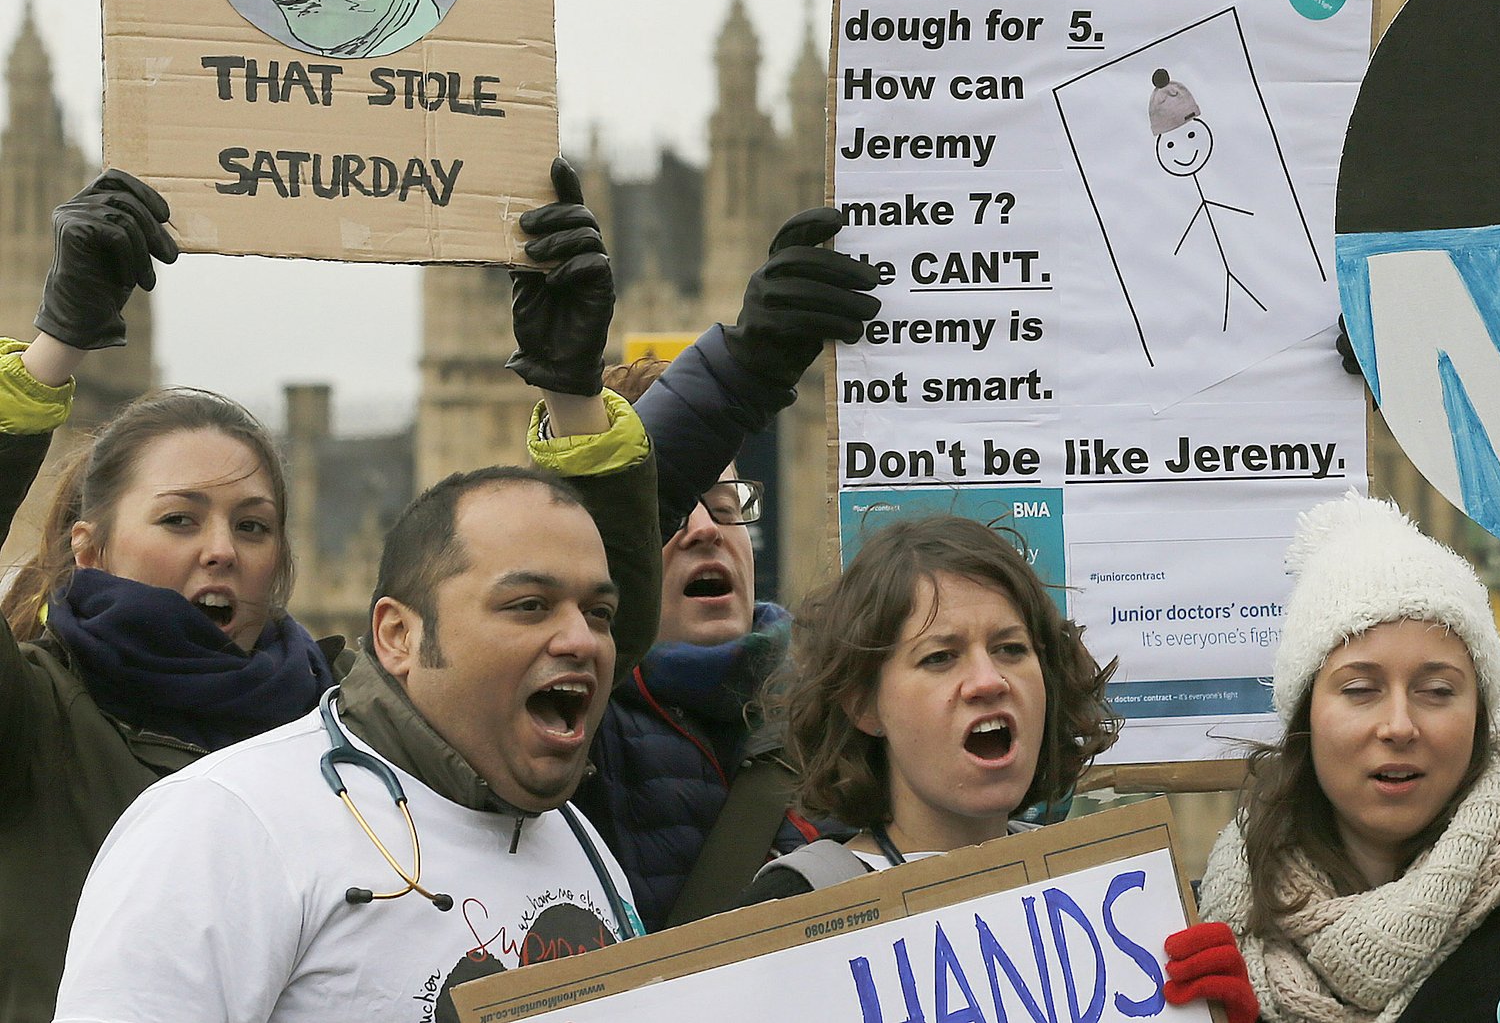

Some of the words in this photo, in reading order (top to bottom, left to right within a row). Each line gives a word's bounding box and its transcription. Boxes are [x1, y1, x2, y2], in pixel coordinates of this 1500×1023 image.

[844, 9, 971, 50] dough
[985, 8, 1044, 42] for
[1068, 10, 1104, 43] 5.
[201, 56, 344, 108] THAT
[368, 67, 506, 118] STOLE
[844, 68, 936, 101] How
[949, 70, 1025, 100] can
[840, 127, 996, 168] Jeremy
[214, 147, 463, 207] SATURDAY
[841, 193, 956, 227] make
[969, 192, 1017, 225] 7?
[844, 253, 896, 285] e
[911, 250, 1052, 285] CAN'T.
[865, 320, 996, 351] eremy
[1009, 309, 1044, 342] is
[843, 371, 908, 404] not
[921, 368, 1053, 403] smart.
[845, 440, 967, 478] Don't
[983, 439, 1041, 476] be
[1064, 438, 1150, 476] like
[1164, 436, 1346, 479] Jeremy.
[1013, 502, 1050, 518] BMA
[1090, 571, 1166, 584] #juniorcontract
[1111, 605, 1163, 625] Junior
[1166, 602, 1235, 621] doctors'
[1142, 630, 1162, 647] It's
[1166, 627, 1247, 649] everyone's
[1143, 693, 1172, 702] contract
[526, 890, 558, 910] have
[558, 888, 574, 900] no
[804, 918, 845, 939] 607080
[847, 907, 880, 927] 08445
[848, 870, 1166, 1023] HANDS
[480, 983, 606, 1023] www.IronMountain.co.uk
